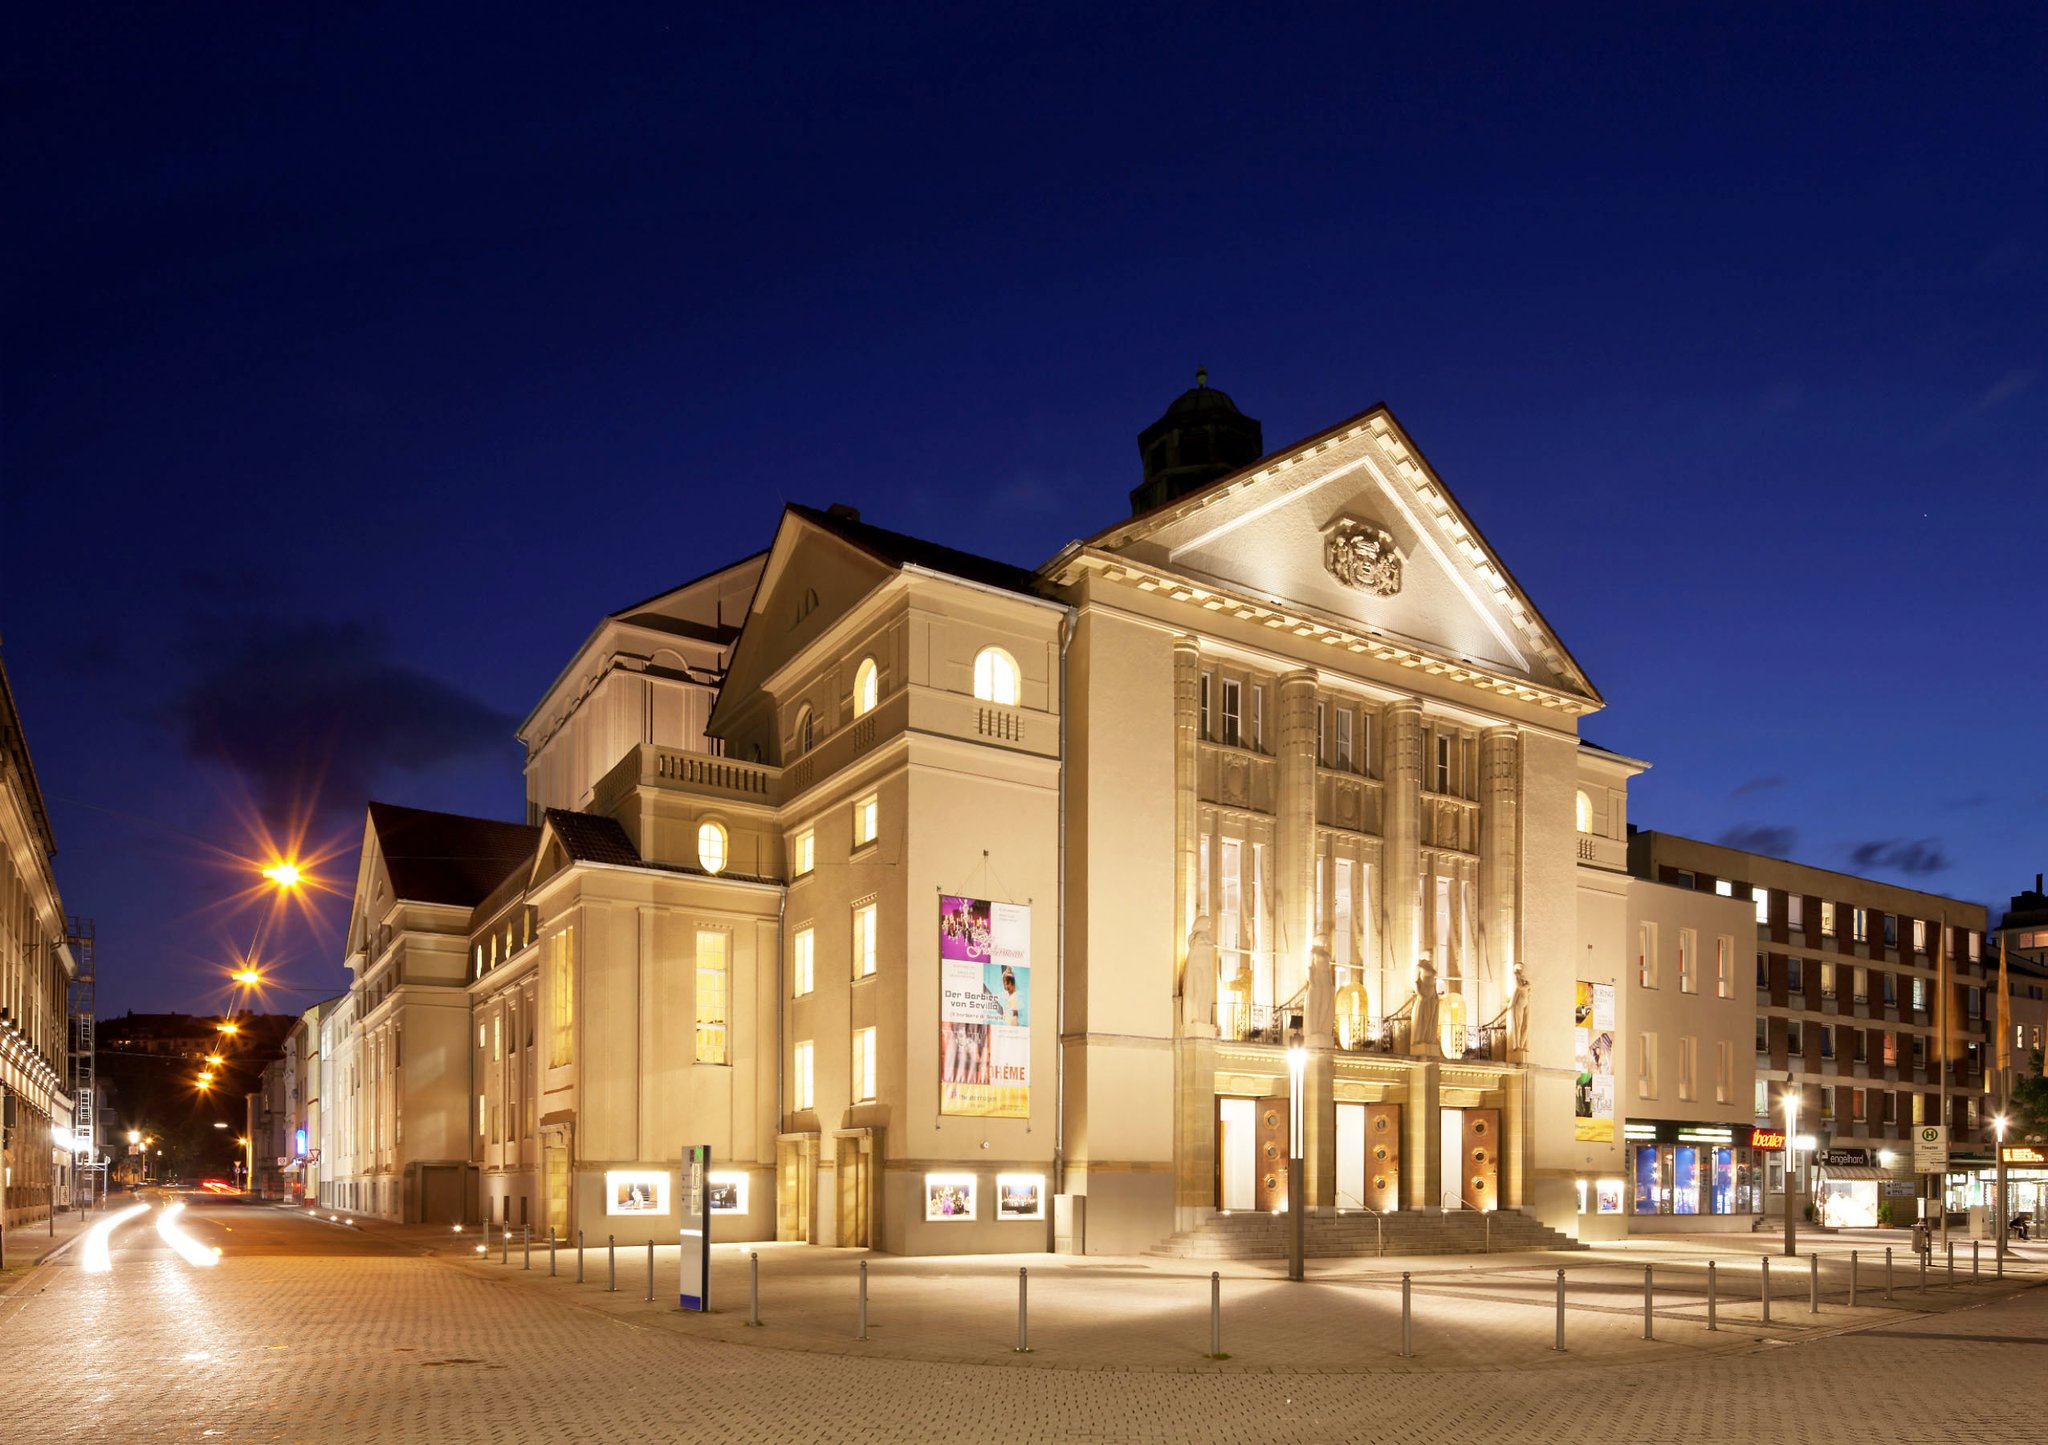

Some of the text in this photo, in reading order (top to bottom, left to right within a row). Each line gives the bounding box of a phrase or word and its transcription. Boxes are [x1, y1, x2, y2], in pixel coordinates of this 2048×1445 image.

[945, 990, 998, 1001] Der Barbier
[969, 1001, 998, 1010] Sevilla
[1752, 1129, 1785, 1148] theater
[1830, 1154, 1864, 1165] engelhard
